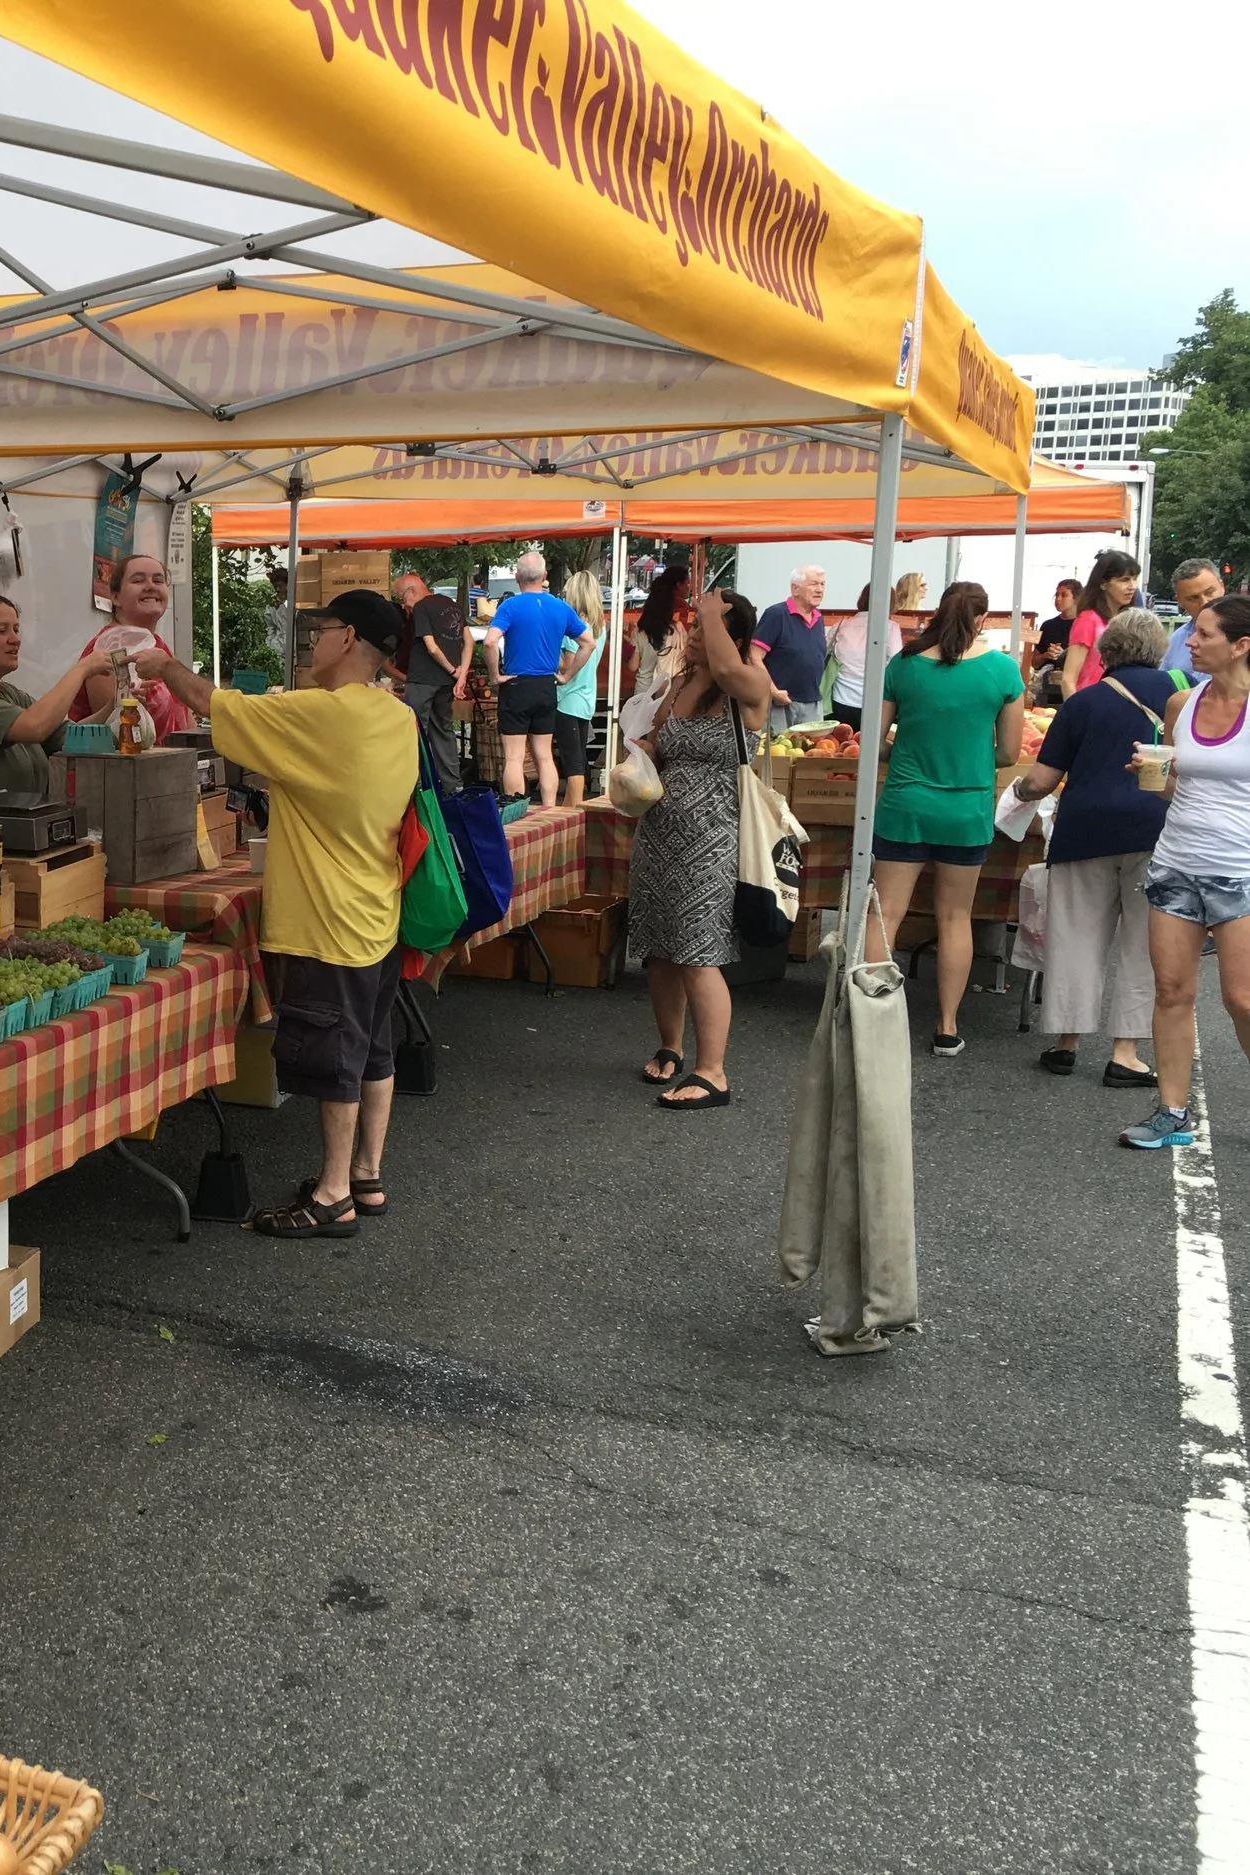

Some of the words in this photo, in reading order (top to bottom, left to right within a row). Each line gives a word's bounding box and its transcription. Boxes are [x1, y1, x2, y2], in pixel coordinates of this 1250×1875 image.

[290, 0, 546, 155] ker
[560, 0, 693, 267] Valley
[696, 101, 829, 322] Orchards
